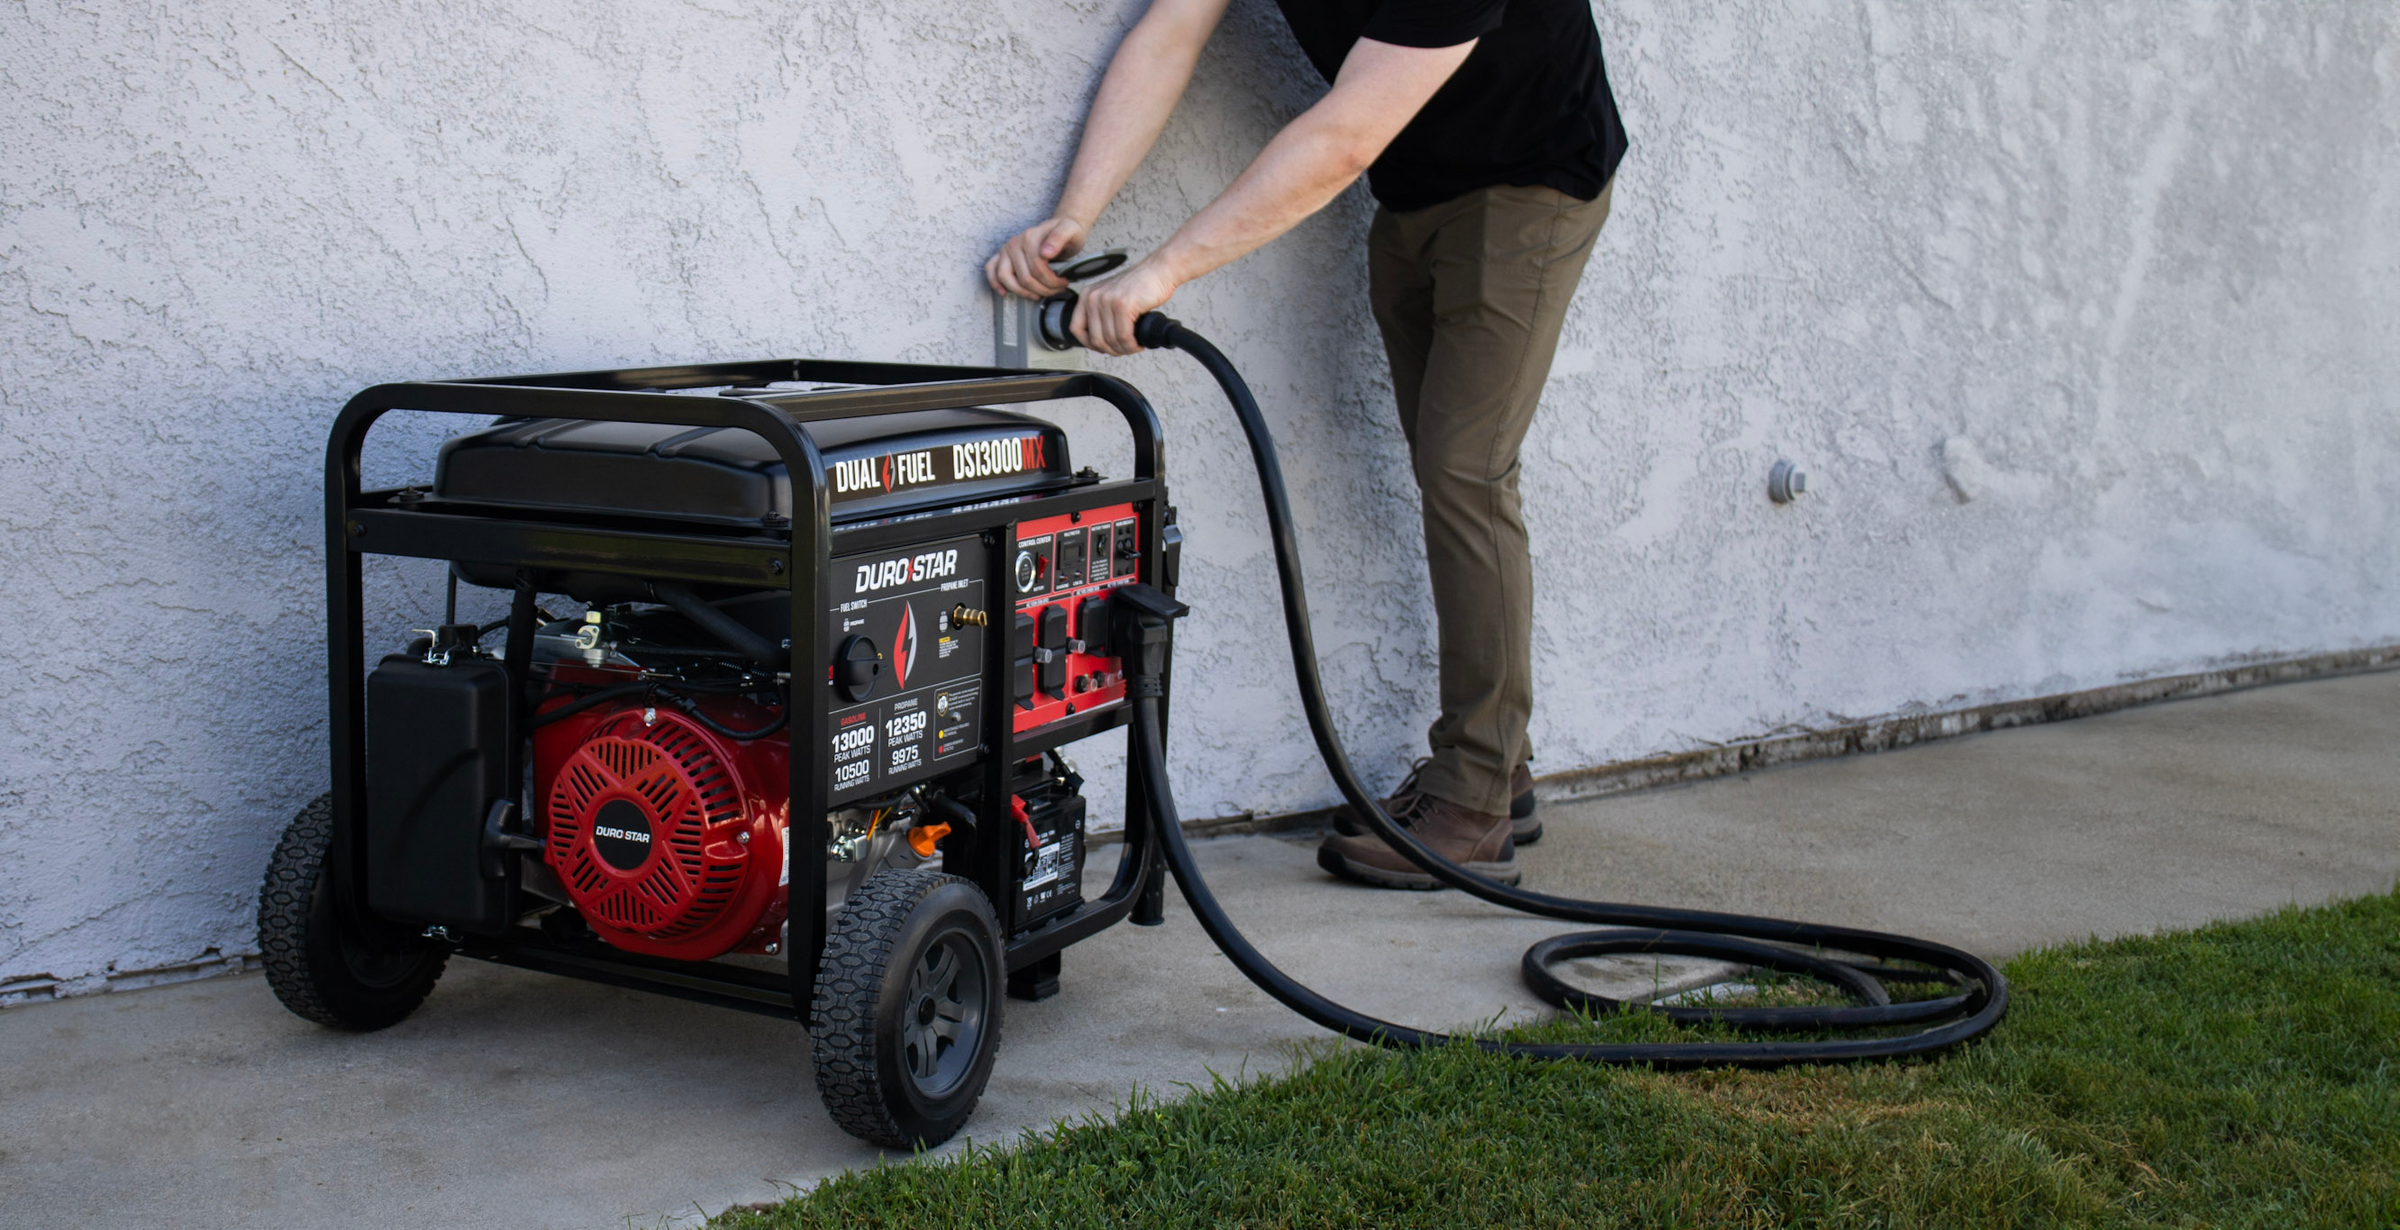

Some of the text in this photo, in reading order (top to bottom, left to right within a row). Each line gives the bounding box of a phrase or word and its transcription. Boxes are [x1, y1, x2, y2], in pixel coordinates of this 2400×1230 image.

[835, 457, 881, 493] DUAL
[897, 451, 936, 485] FUEL
[1018, 538, 1036, 549] CONTROL
[1036, 535, 1052, 545] CENTER
[958, 578, 969, 589] INLET
[840, 602, 851, 613] FUEL
[894, 697, 918, 711] PROPANE
[840, 712, 867, 727] GASOLINE
[885, 710, 927, 738] 12350
[831, 725, 875, 753] 13000
[888, 729, 923, 748] PEAK WATTS
[834, 745, 871, 764] PEAK WATTS
[891, 744, 919, 766] 9975
[834, 759, 870, 782] 10500
[888, 758, 922, 775] RUNNING WATTS
[834, 775, 870, 792] RUNNING WATTS
